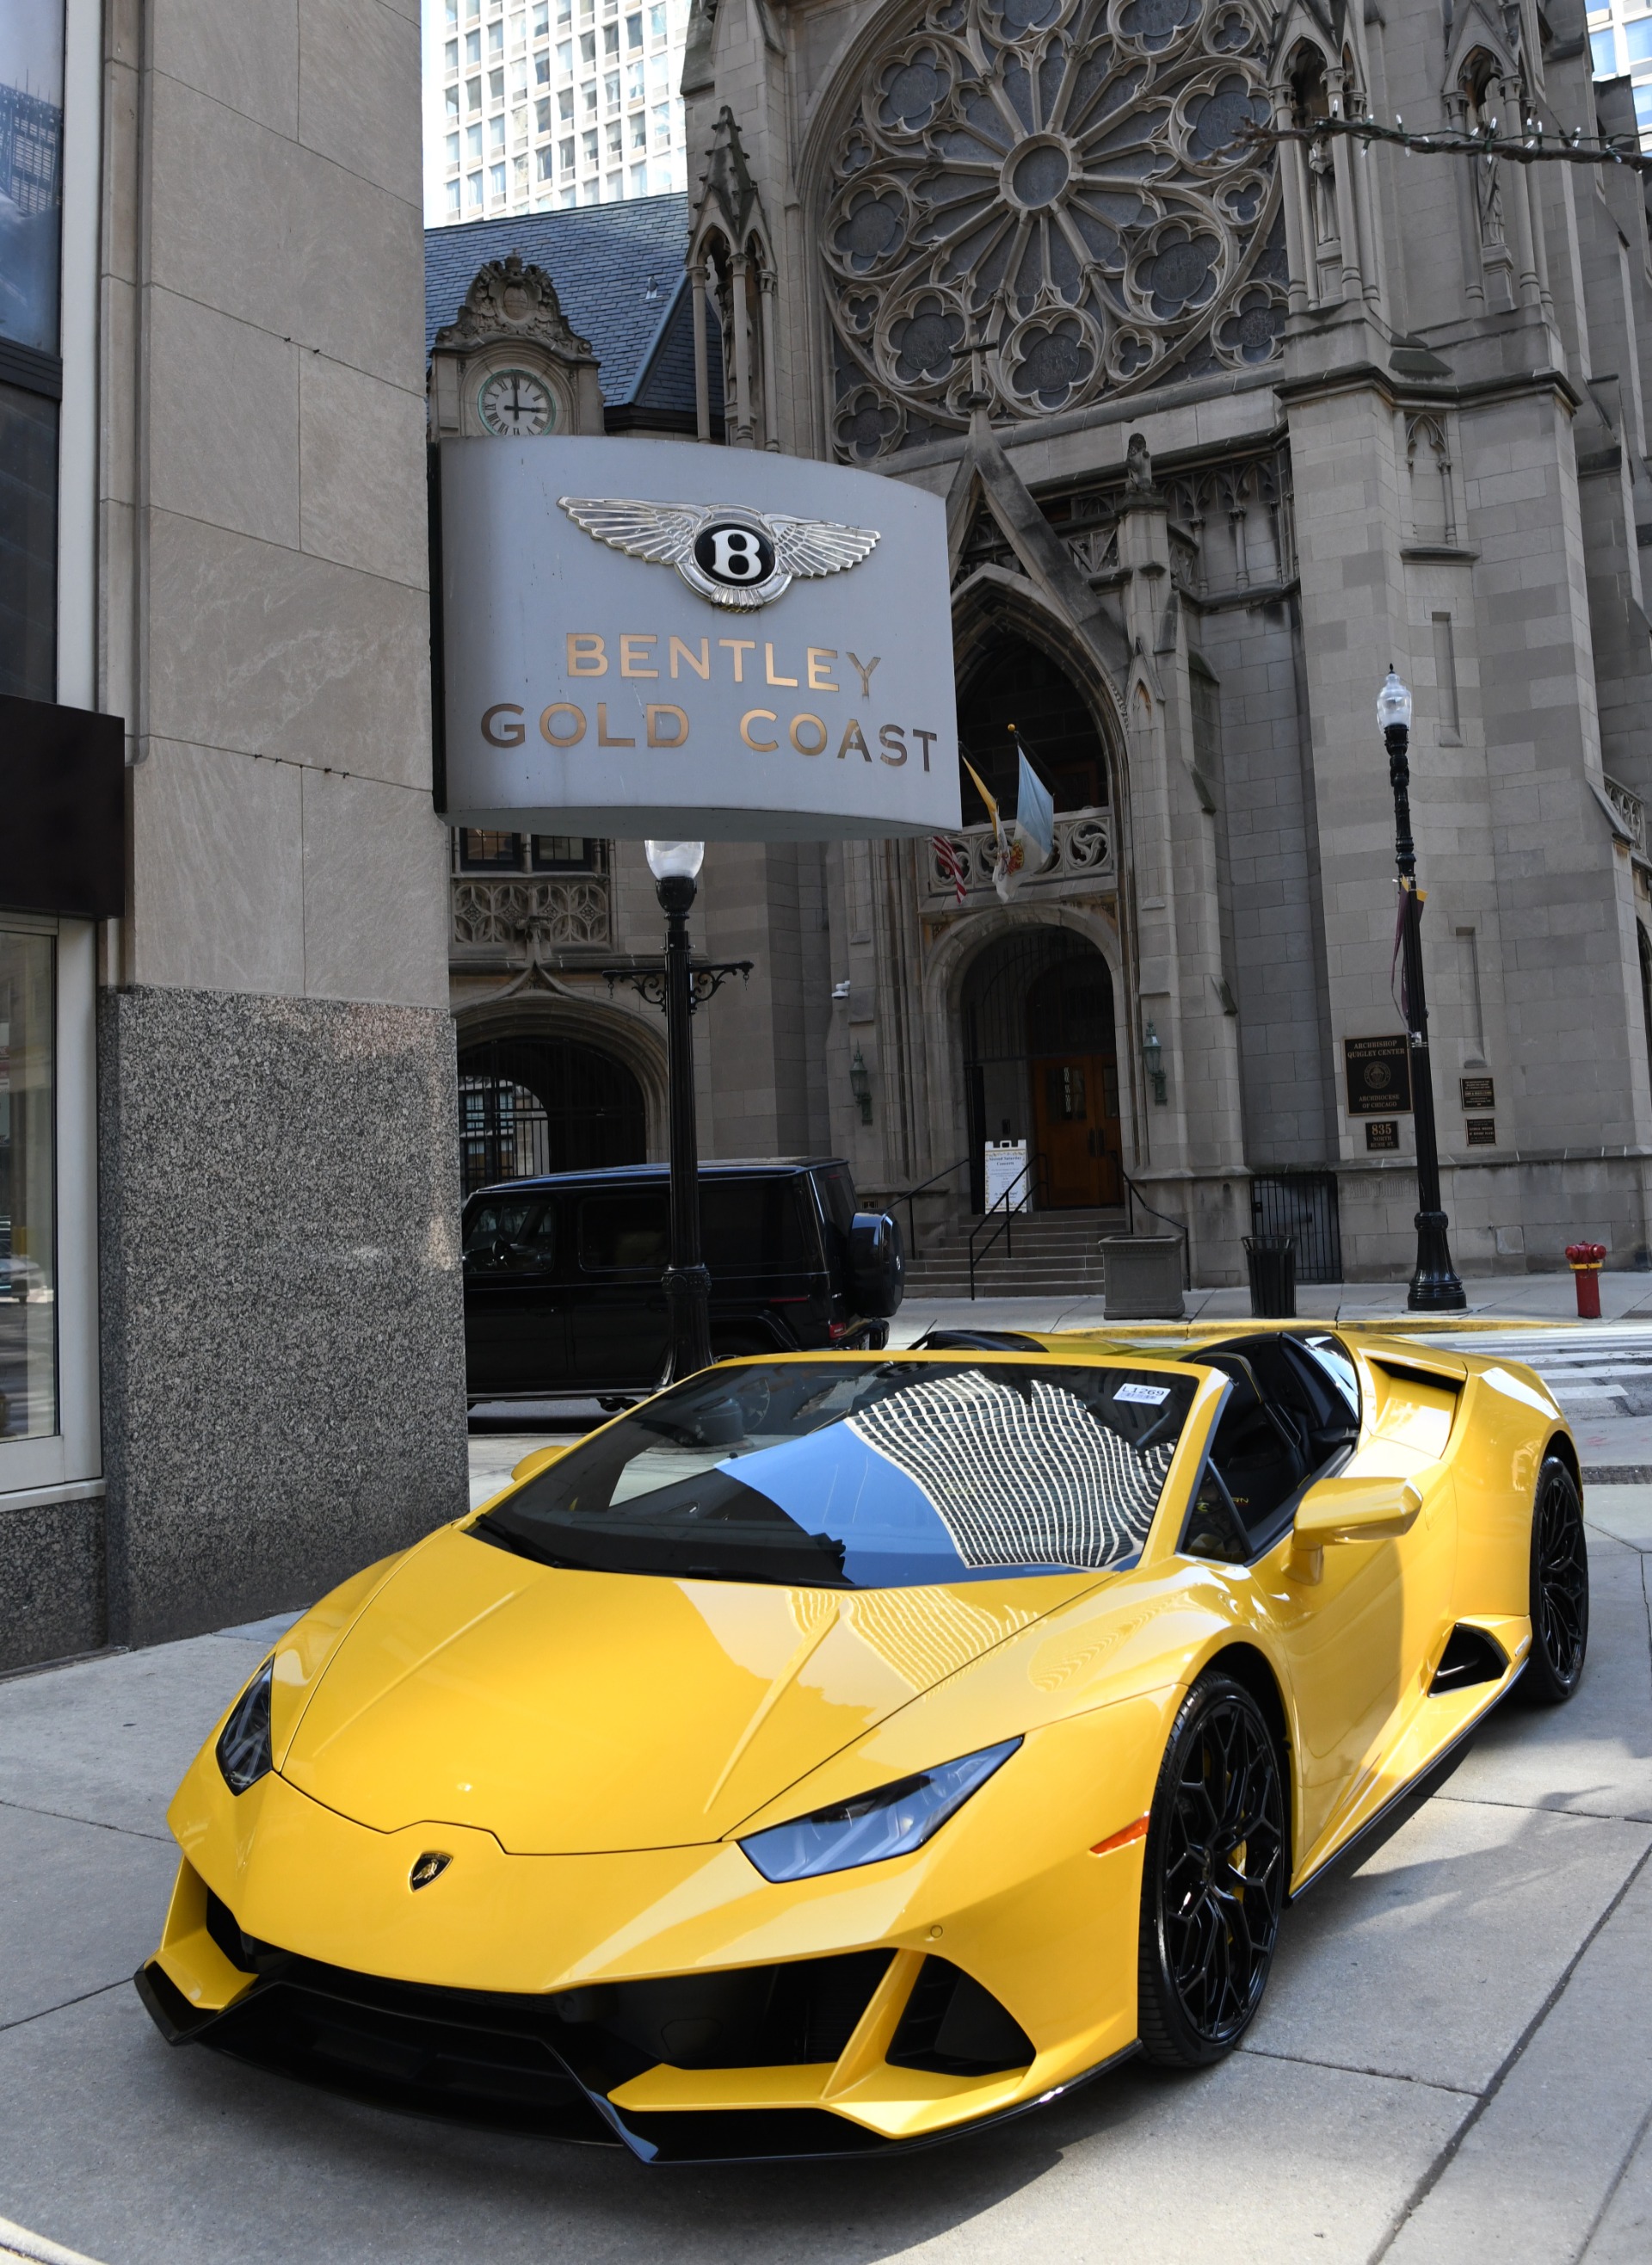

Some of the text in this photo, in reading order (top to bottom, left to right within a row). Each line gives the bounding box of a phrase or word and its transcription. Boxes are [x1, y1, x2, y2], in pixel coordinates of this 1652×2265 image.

[711, 529, 762, 580] B
[566, 633, 882, 697] BENTLEY
[480, 702, 938, 773] GOLD COAST
[1353, 1040, 1397, 1049] ARCHBISHOP
[1347, 1047, 1405, 1059] QUIGLEY CENTER
[1372, 1123, 1392, 1136] 835
[1122, 1386, 1164, 1396] L1269
